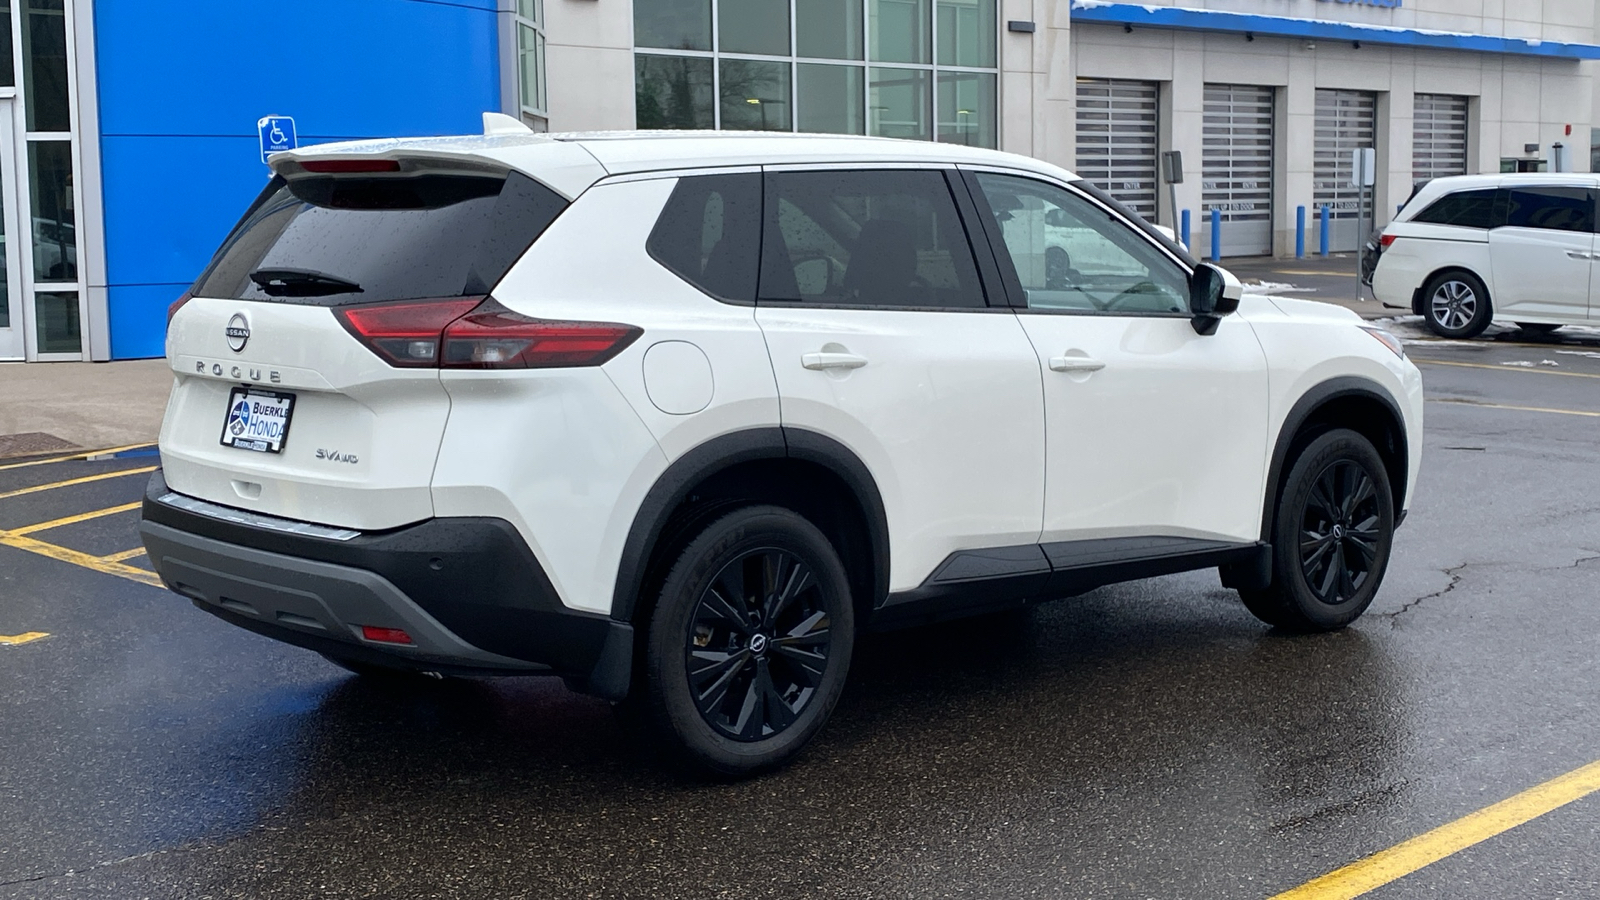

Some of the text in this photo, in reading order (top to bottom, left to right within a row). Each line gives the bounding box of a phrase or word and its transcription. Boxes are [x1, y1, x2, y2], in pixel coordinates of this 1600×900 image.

[196, 361, 281, 383] ROGUE
[248, 415, 285, 439] HONDA
[315, 448, 338, 460] SV
